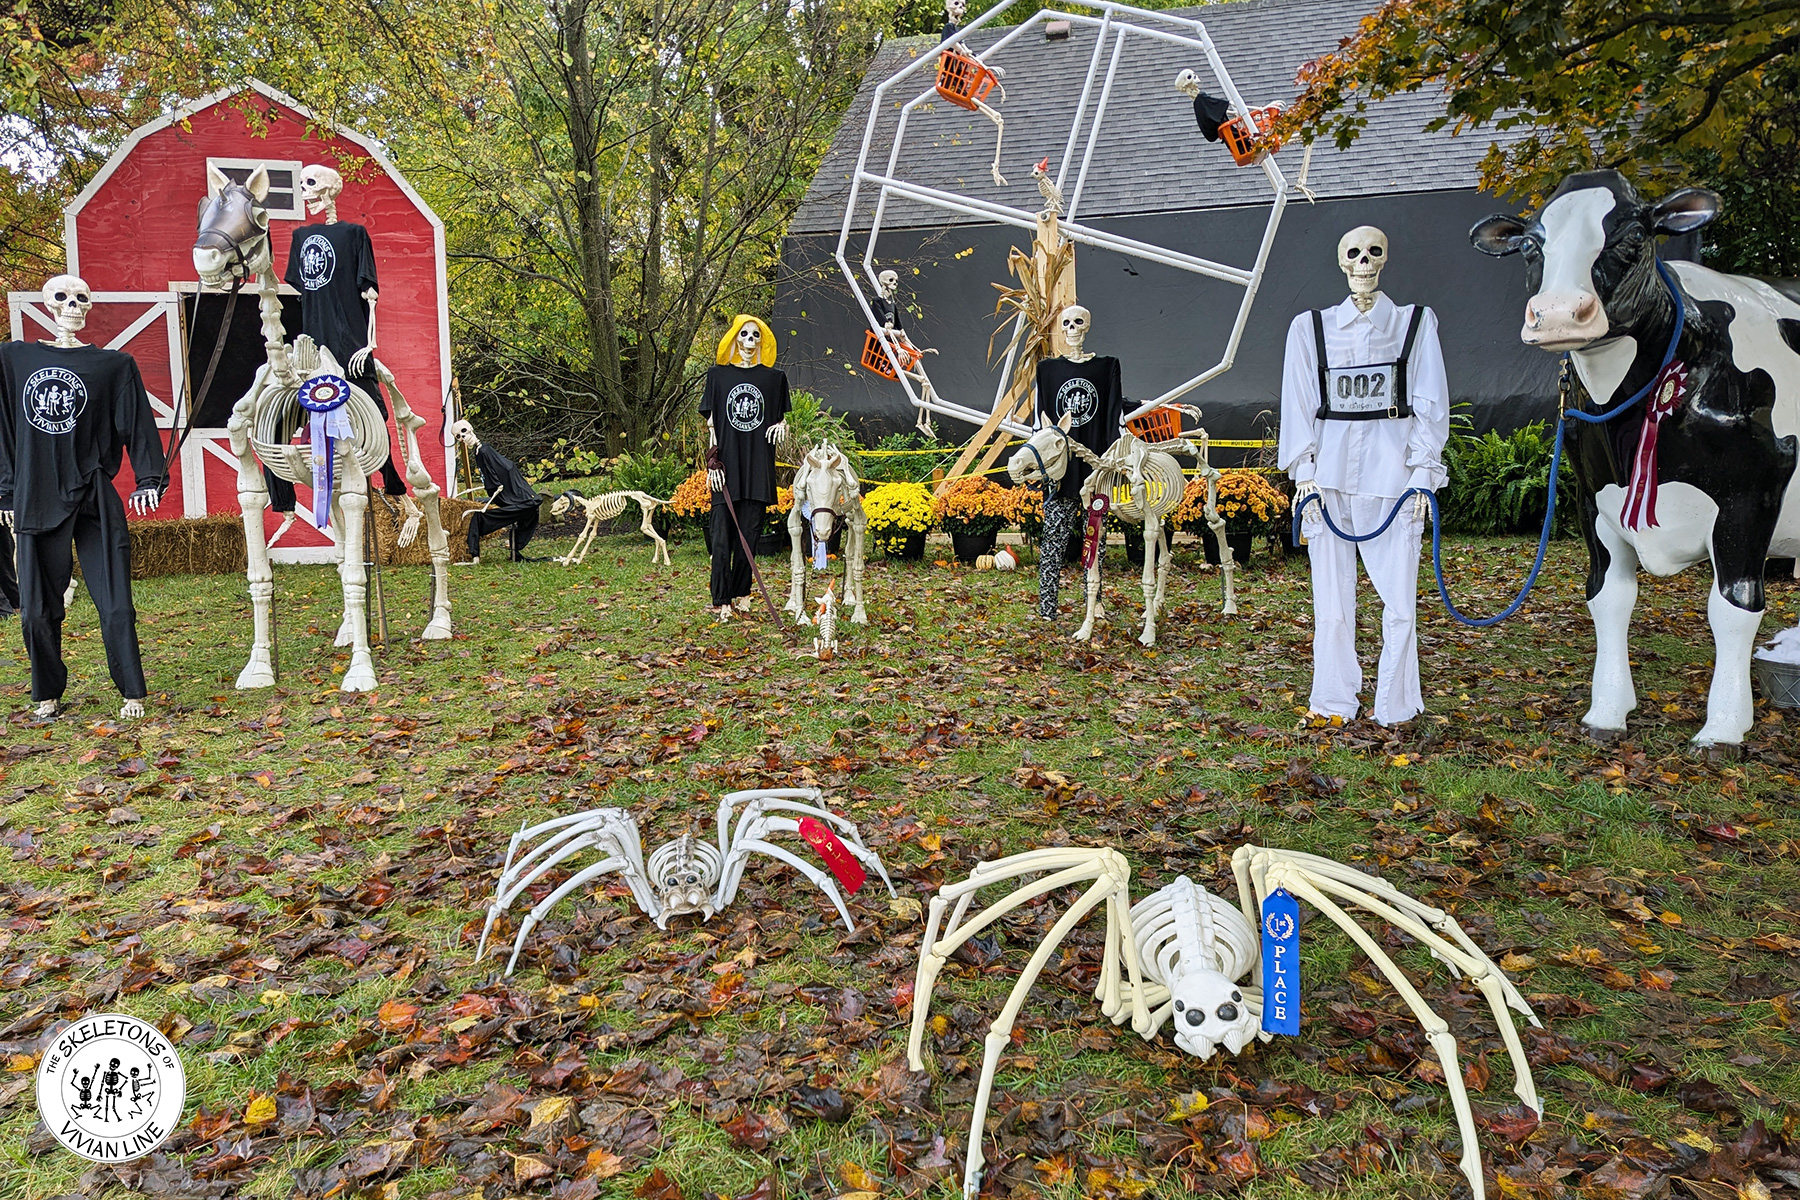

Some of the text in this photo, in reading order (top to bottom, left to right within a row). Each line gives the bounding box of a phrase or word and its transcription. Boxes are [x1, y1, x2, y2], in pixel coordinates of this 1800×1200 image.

[30, 369, 82, 390] SKELETONS
[1337, 372, 1386, 399] 002
[1274, 945, 1287, 1020] PLACE
